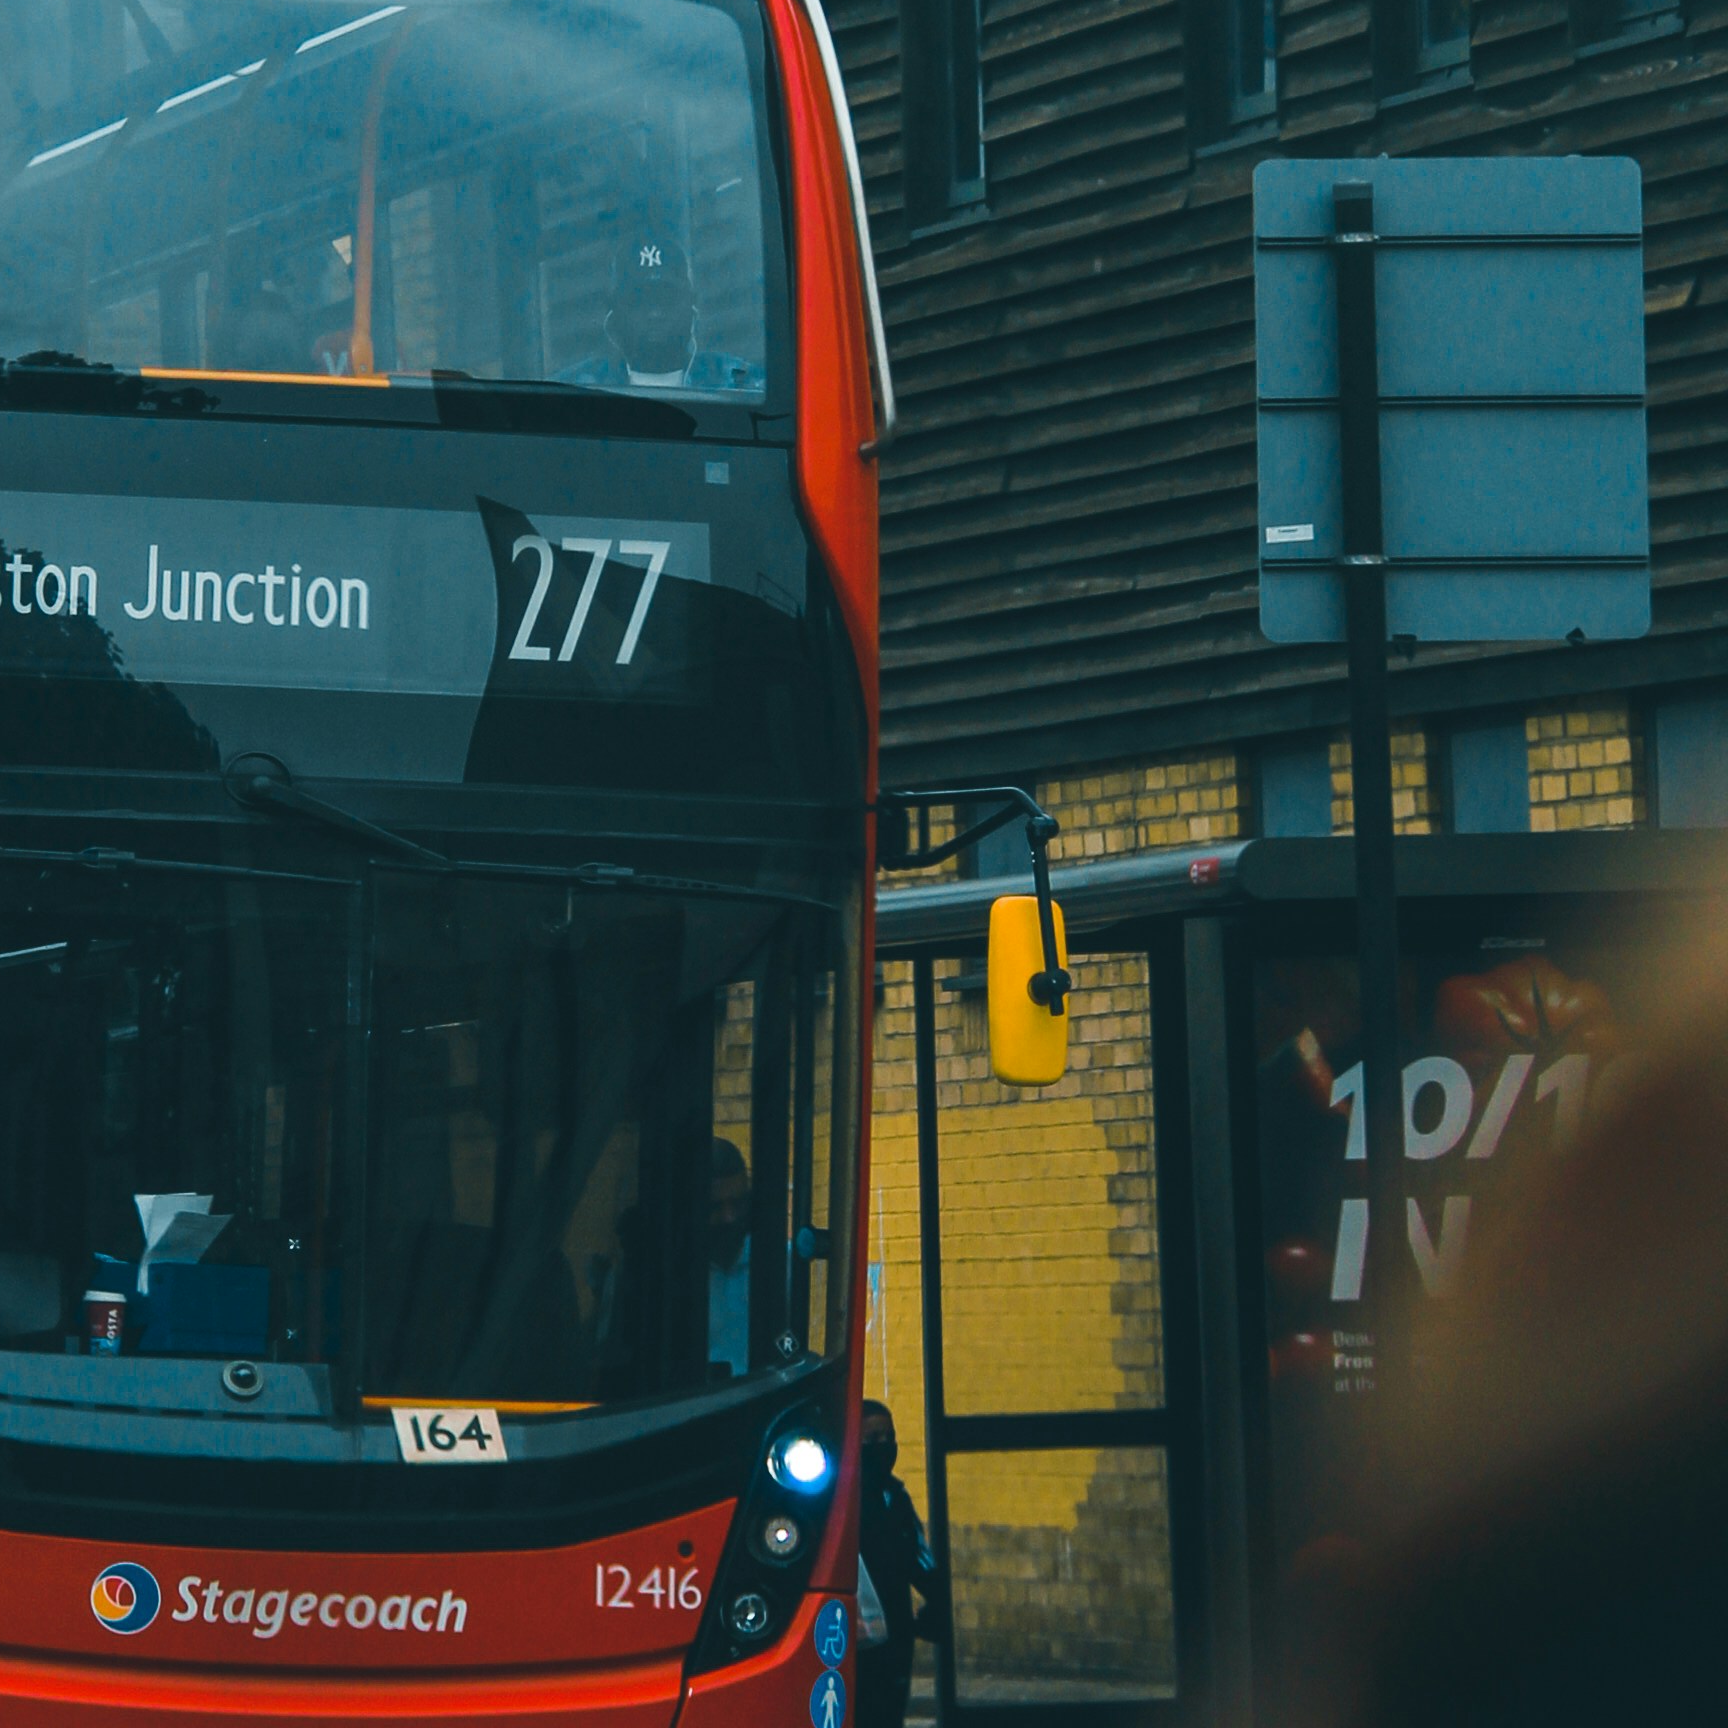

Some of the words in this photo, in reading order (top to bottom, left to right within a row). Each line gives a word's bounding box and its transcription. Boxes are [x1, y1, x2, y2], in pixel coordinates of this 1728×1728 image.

[123, 543, 370, 630] Junction
[508, 534, 672, 666] 277
[410, 1414, 493, 1452] 164
[172, 1574, 468, 1639] Stagecoach
[595, 1563, 703, 1610] 12416
